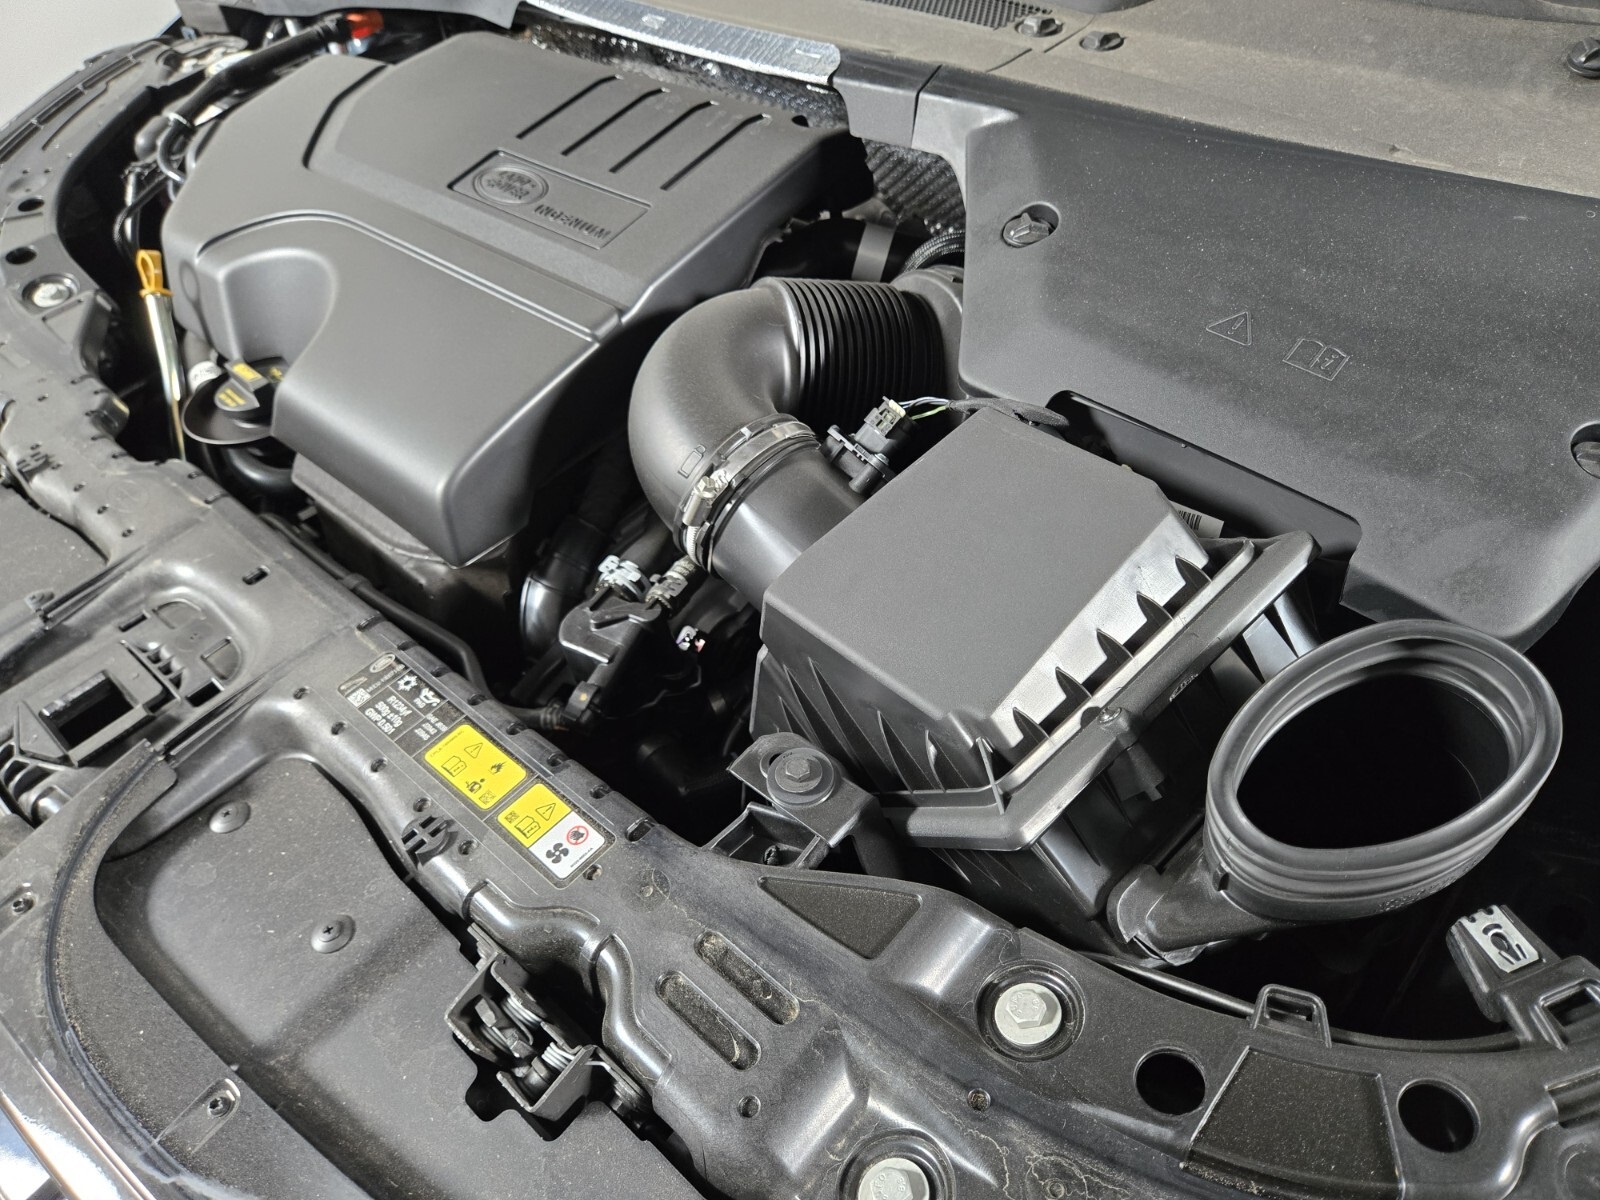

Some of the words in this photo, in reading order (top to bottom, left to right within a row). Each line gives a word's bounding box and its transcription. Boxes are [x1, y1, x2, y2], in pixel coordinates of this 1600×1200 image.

[534, 203, 612, 239] INGENIUM
[375, 701, 391, 716] 500g
[386, 695, 412, 717] R1234yf
[365, 708, 382, 724] GWP
[377, 719, 395, 735] 0.501
